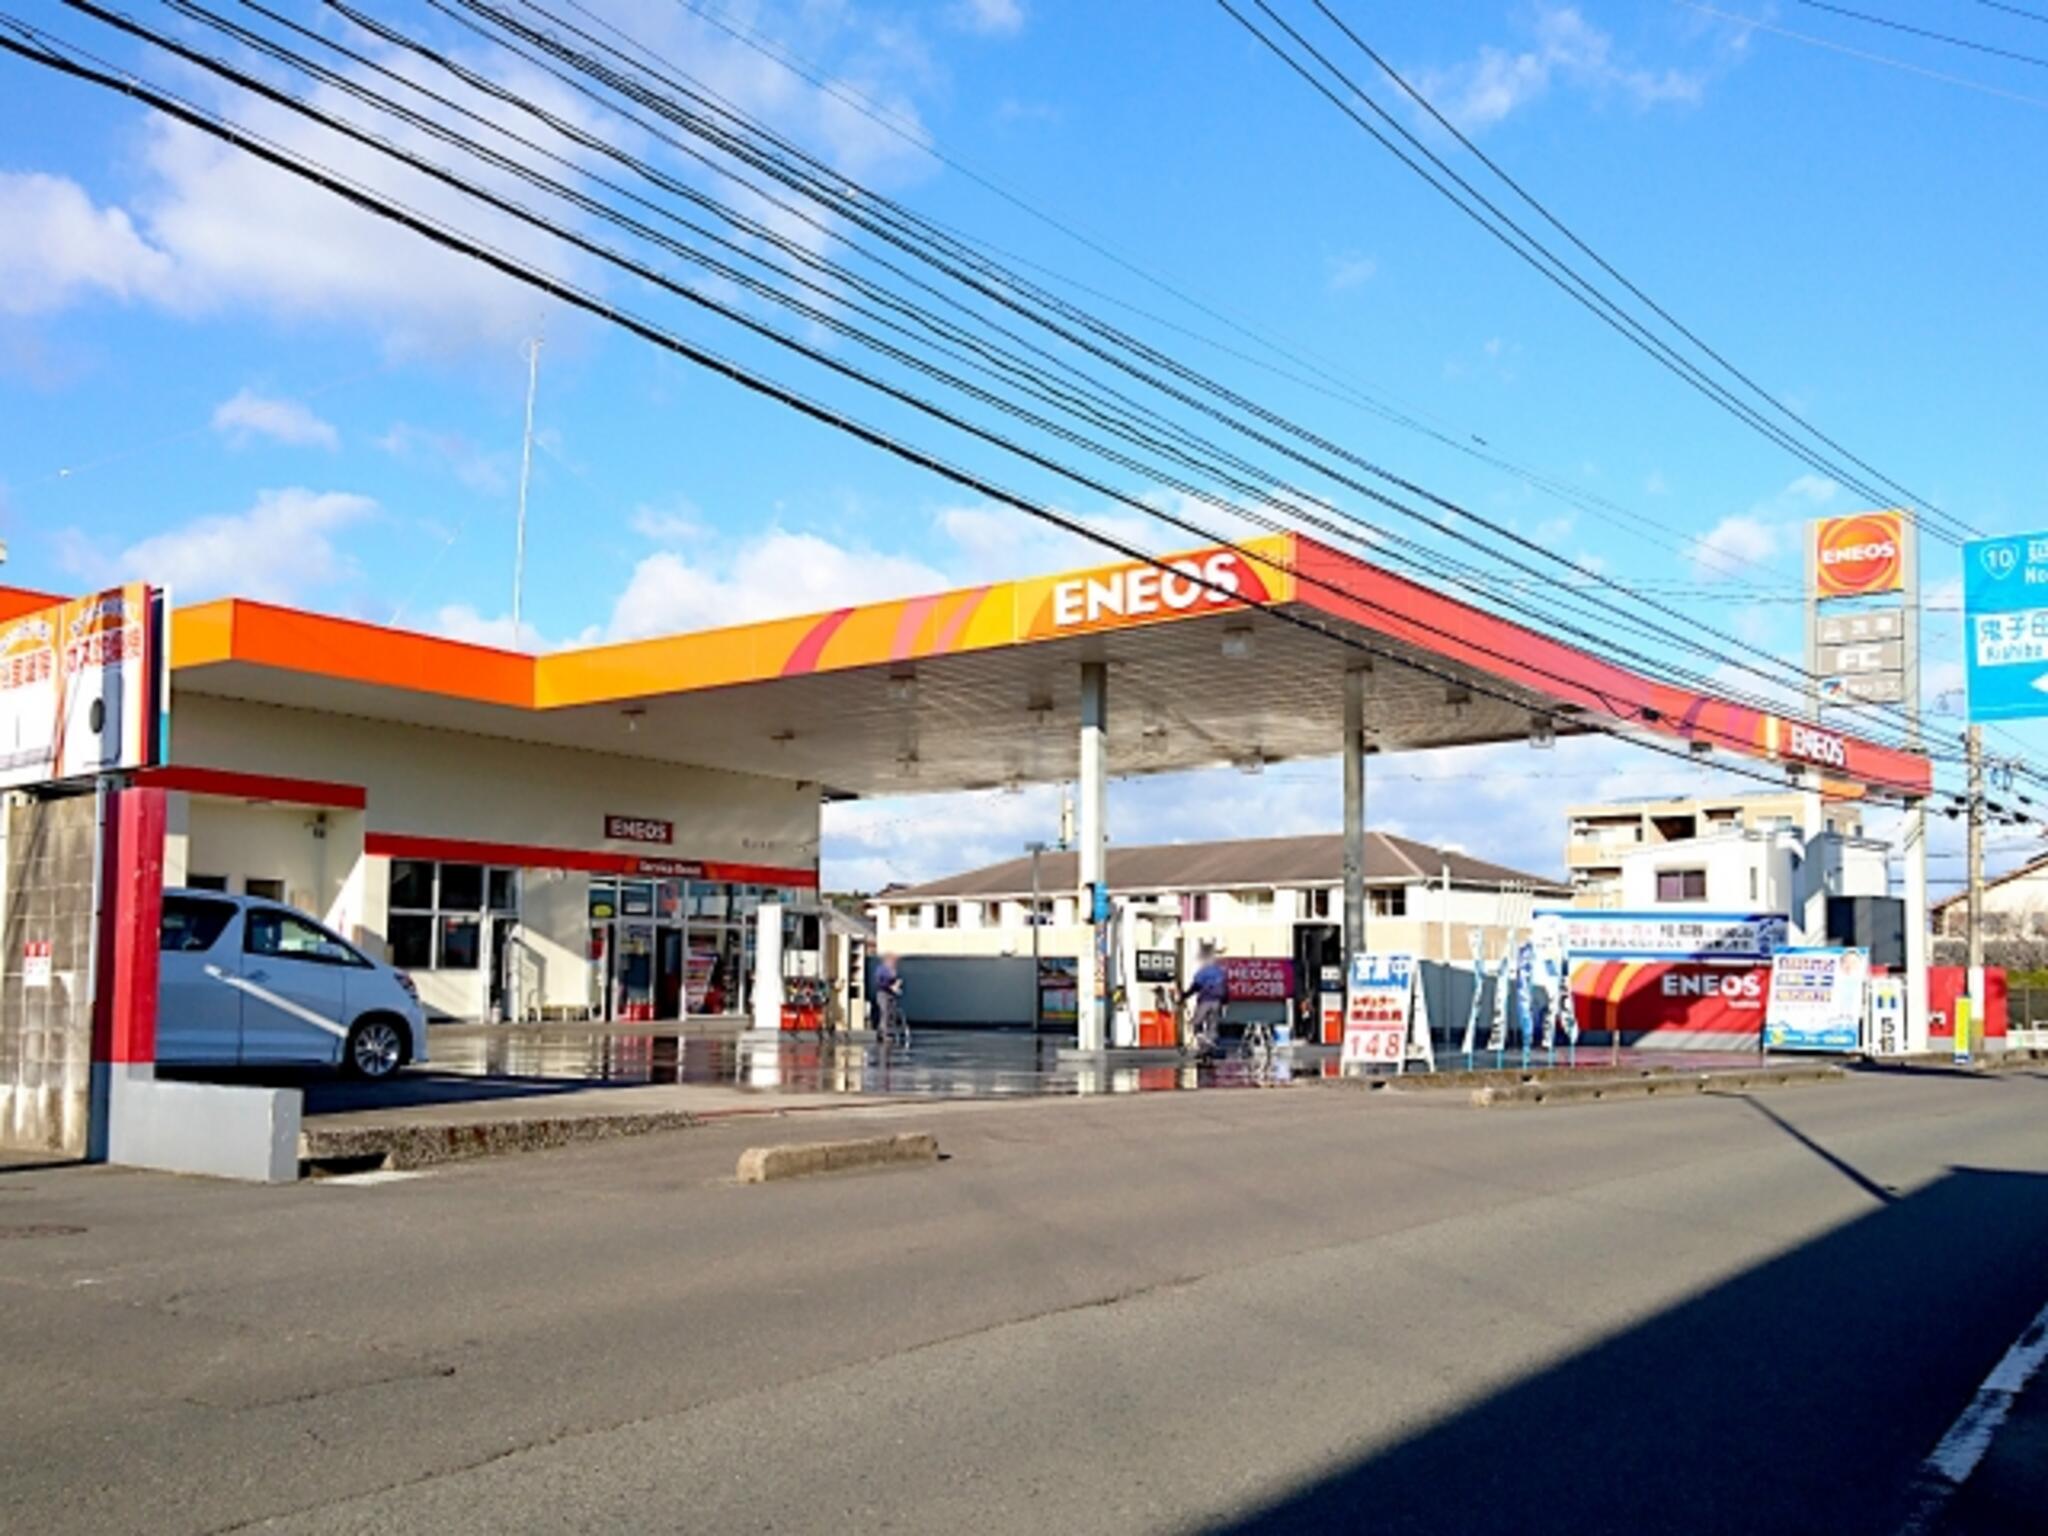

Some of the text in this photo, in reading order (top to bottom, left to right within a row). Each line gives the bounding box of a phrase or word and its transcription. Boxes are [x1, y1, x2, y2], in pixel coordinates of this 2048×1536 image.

[1822, 539, 1895, 565] ENEOS
[1986, 549, 2014, 567] 10
[1053, 553, 1239, 627] ENEOS
[1791, 725, 1844, 766] ENEOS
[610, 819, 666, 840] ENEOS
[1662, 973, 1761, 997] ENEOS
[1351, 1033, 1399, 1057] 148
